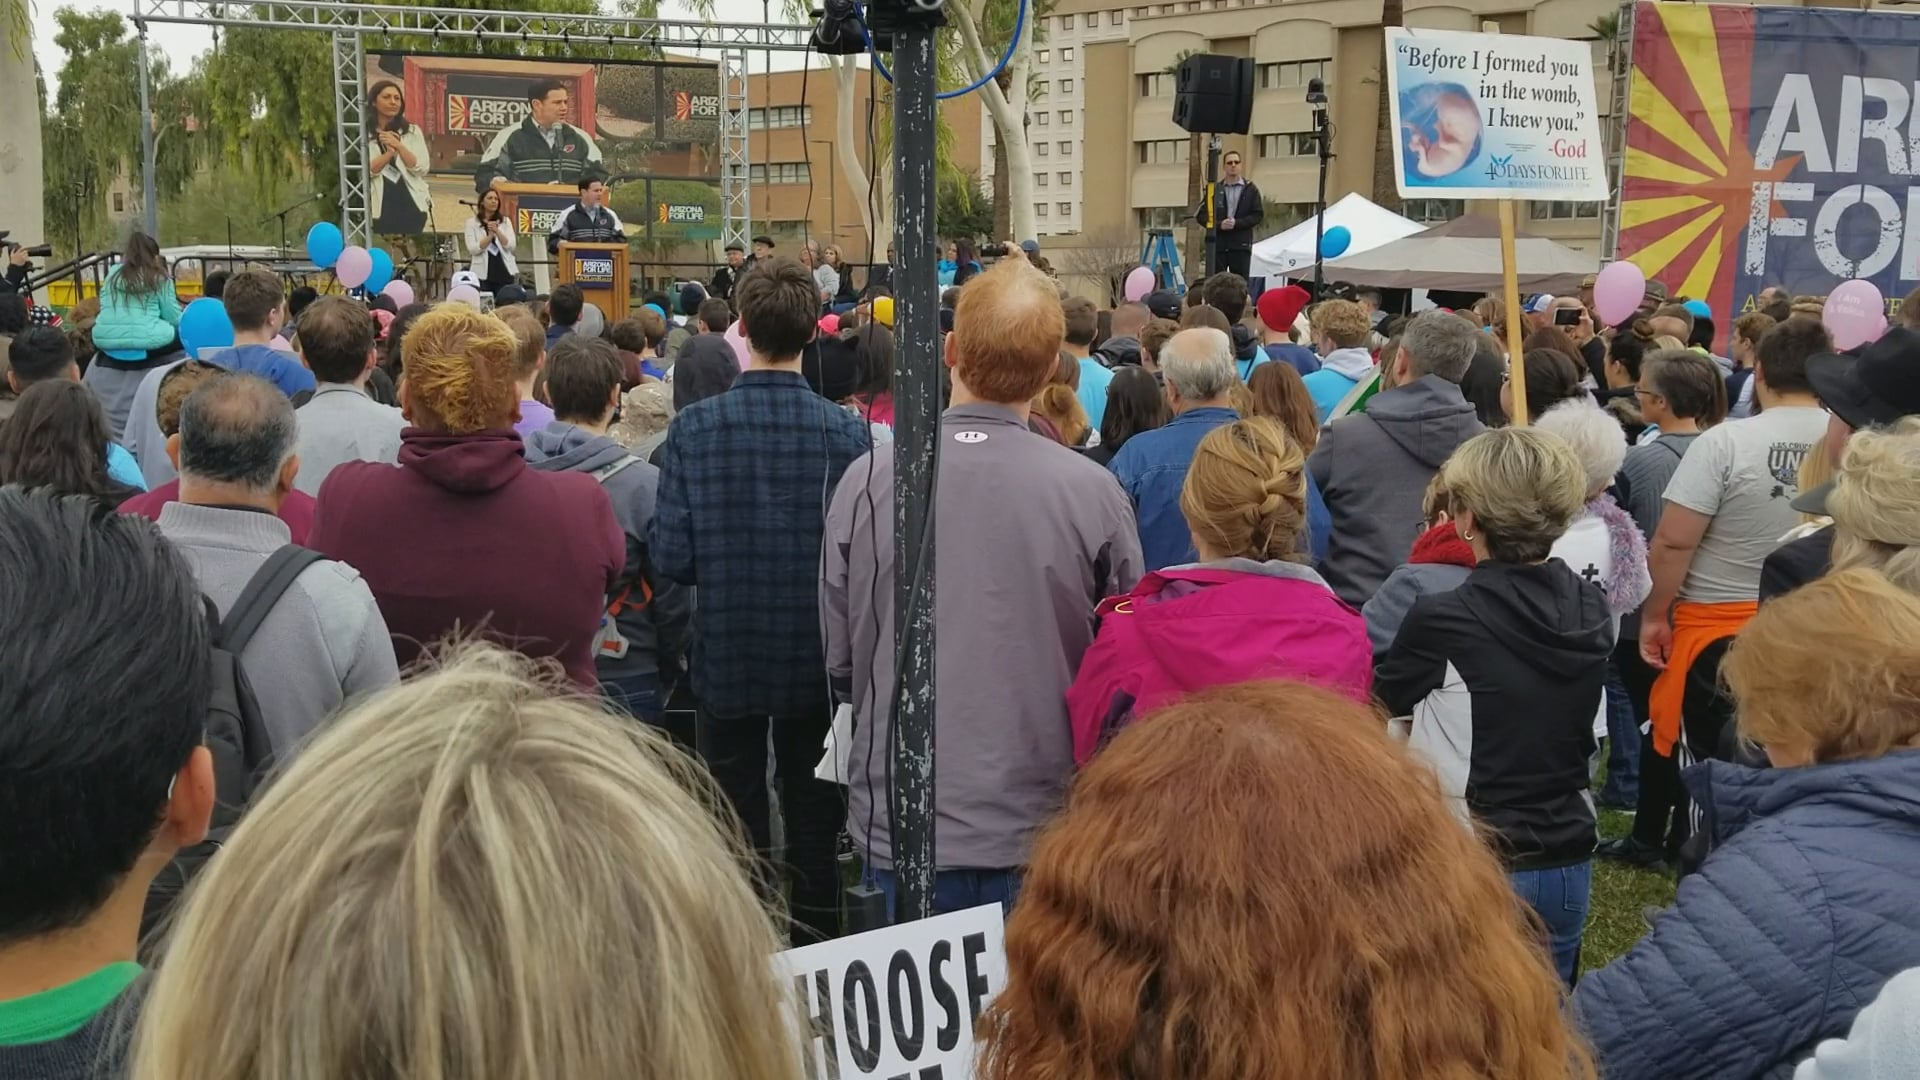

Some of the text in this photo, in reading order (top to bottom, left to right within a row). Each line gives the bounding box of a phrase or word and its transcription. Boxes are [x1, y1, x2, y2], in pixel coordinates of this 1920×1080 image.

[1472, 50, 1480, 70] I
[1482, 50, 1546, 77] formed
[1550, 61, 1579, 80] you
[1479, 79, 1581, 107] in the womb,
[469, 99, 533, 114] ARIZON
[690, 95, 719, 107] ARIZ
[691, 105, 717, 116] FOR
[469, 111, 505, 125] FOR
[1487, 107, 1495, 127] I
[1499, 107, 1543, 129] knew
[669, 205, 704, 214] ARIZONA
[669, 212, 705, 221] FOR LIFE
[794, 931, 989, 1080] HOOSE
